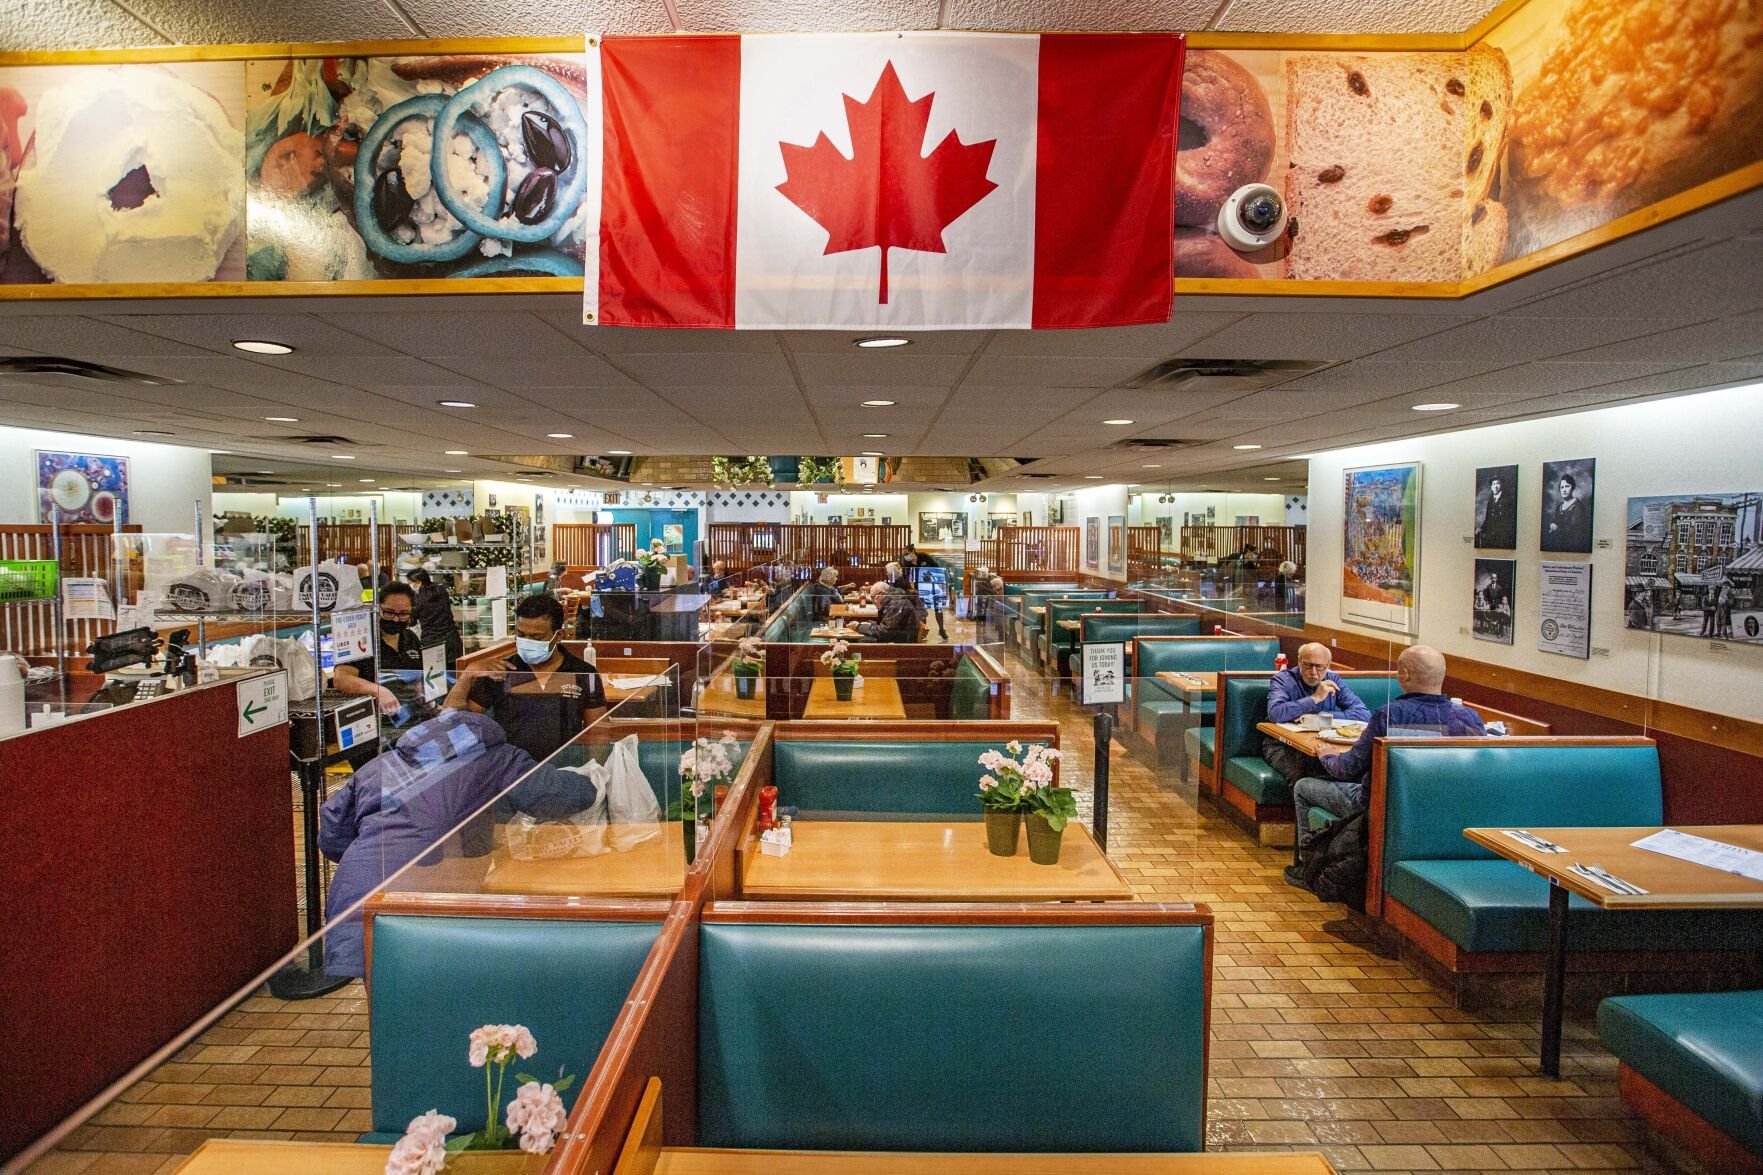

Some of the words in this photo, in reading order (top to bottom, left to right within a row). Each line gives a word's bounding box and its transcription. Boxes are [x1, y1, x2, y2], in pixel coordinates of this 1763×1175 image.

[604, 493, 618, 504] EXIT
[336, 640, 350, 648] UBER
[1090, 647, 1106, 655] THANK
[263, 685, 276, 697] EXIT
